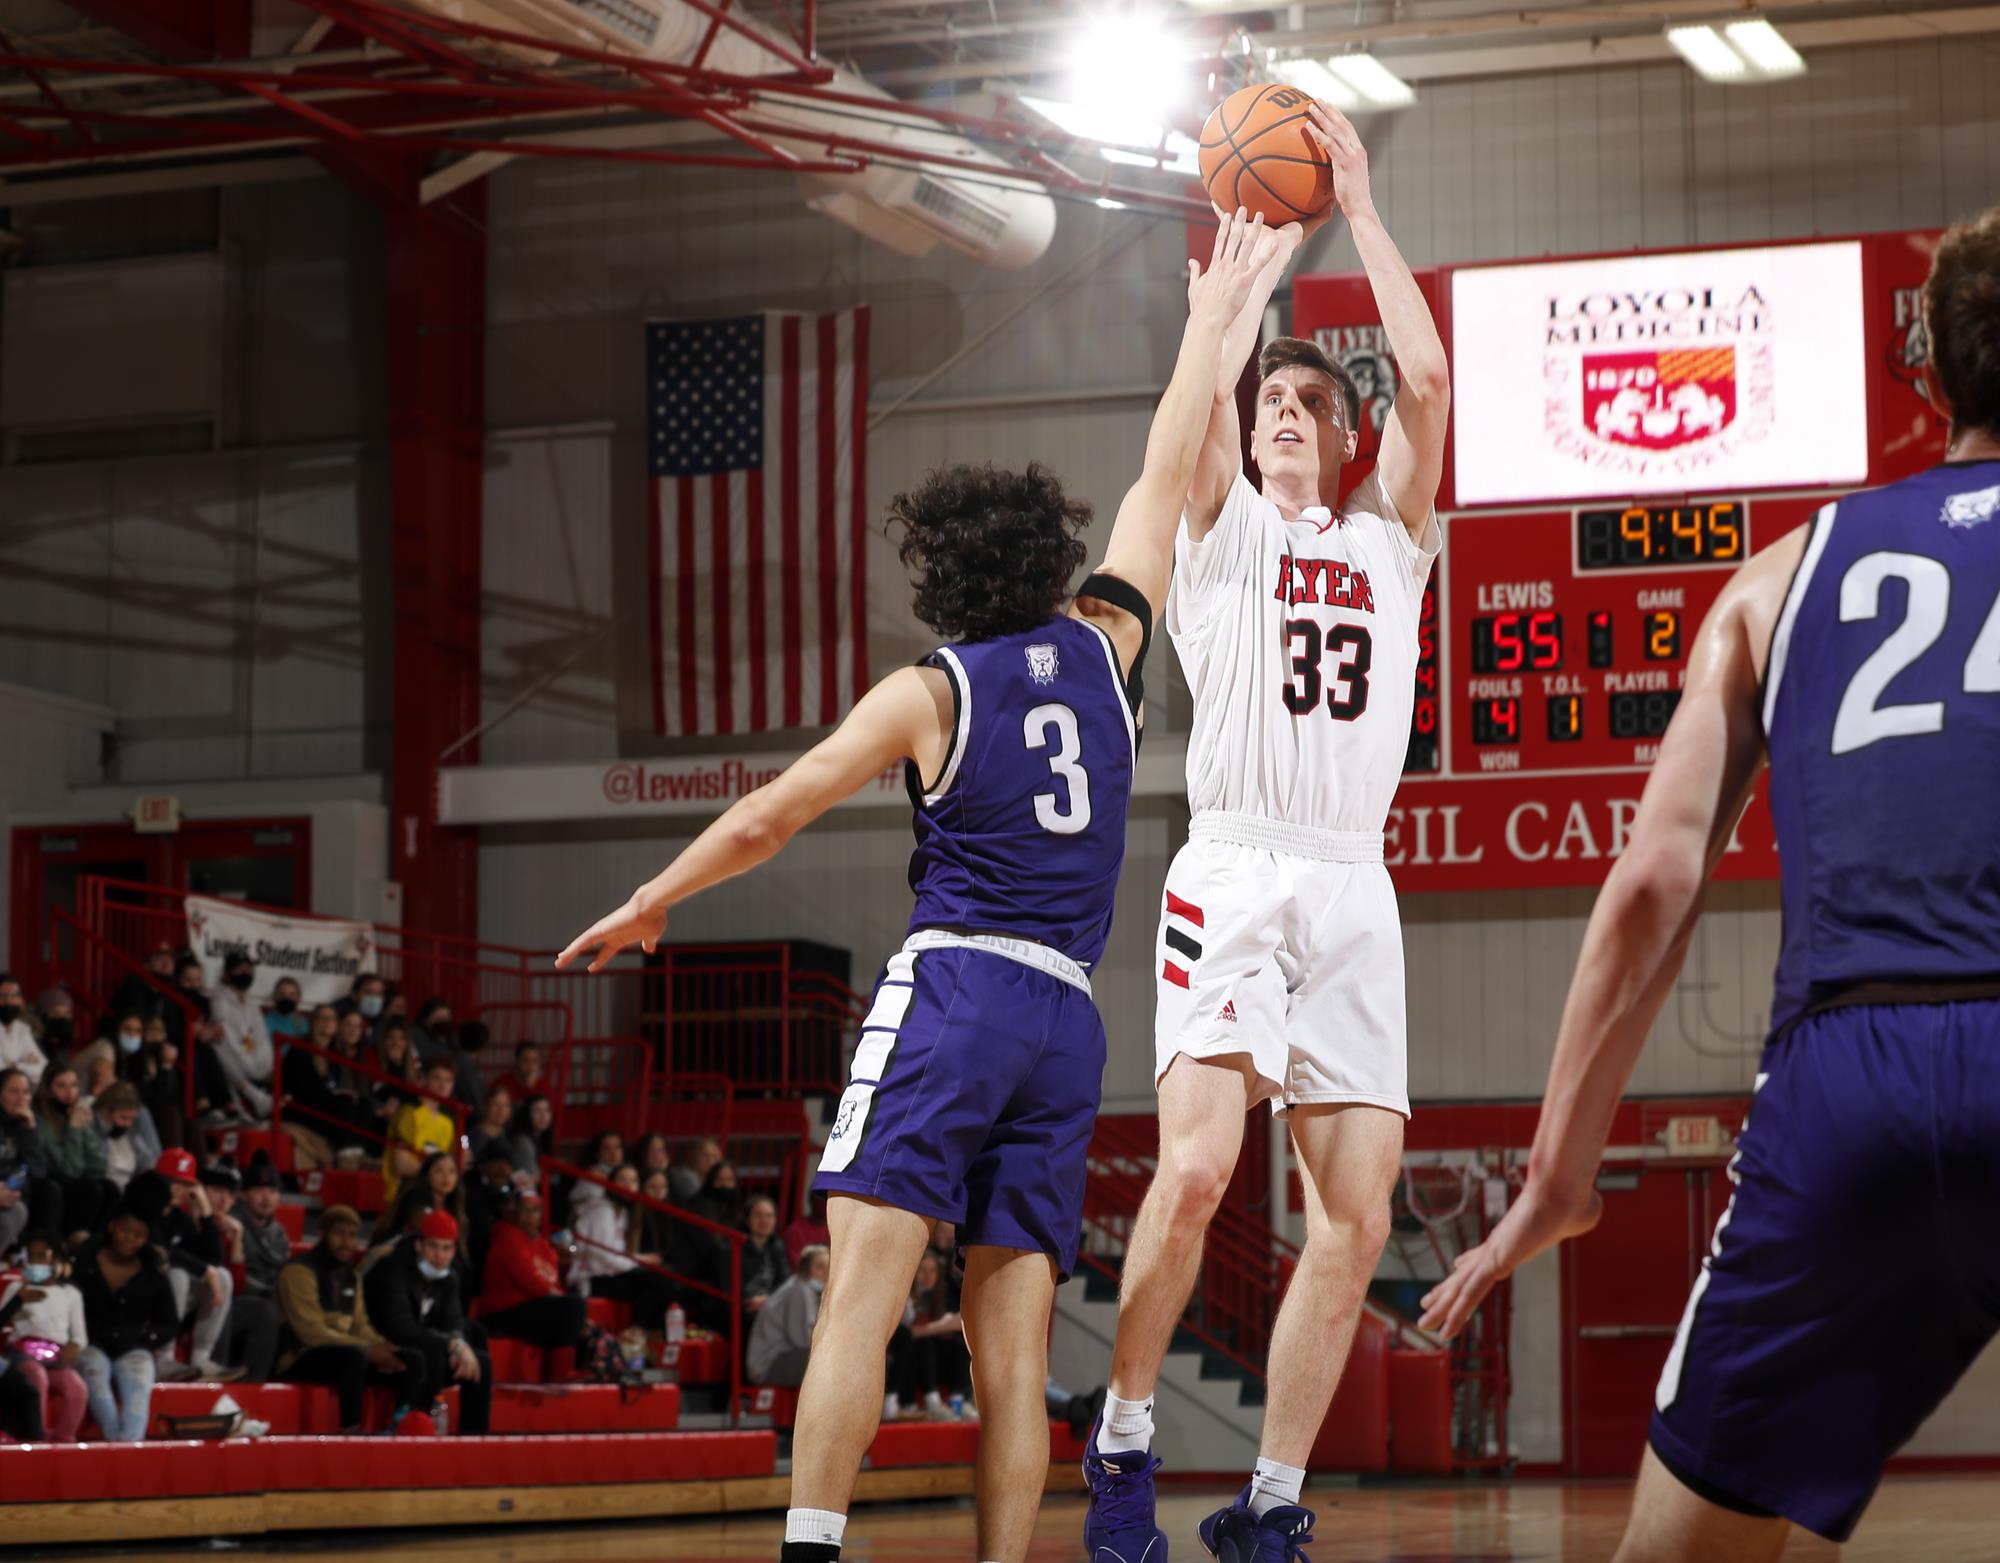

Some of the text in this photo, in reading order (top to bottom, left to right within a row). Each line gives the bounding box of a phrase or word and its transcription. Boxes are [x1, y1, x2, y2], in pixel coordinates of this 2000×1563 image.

[1547, 284, 1767, 320] LOYOLA
[1315, 325, 1391, 358] FLYER
[1546, 313, 1766, 345] MEDICINE
[1620, 503, 1739, 558] 9:45
[1478, 581, 1553, 611] LEWIS
[1637, 588, 1685, 609] GAME
[1493, 612, 1560, 670] 55
[1651, 612, 1675, 656] 2
[1282, 618, 1372, 721] 33
[1542, 676, 1588, 695] T.O.L.
[1604, 671, 1669, 692] PLAYER
[1469, 678, 1523, 699] FOULS
[1491, 699, 1516, 737] 4
[1023, 703, 1091, 833] 3
[1480, 751, 1520, 770] WON
[1383, 804, 1484, 866] EIL
